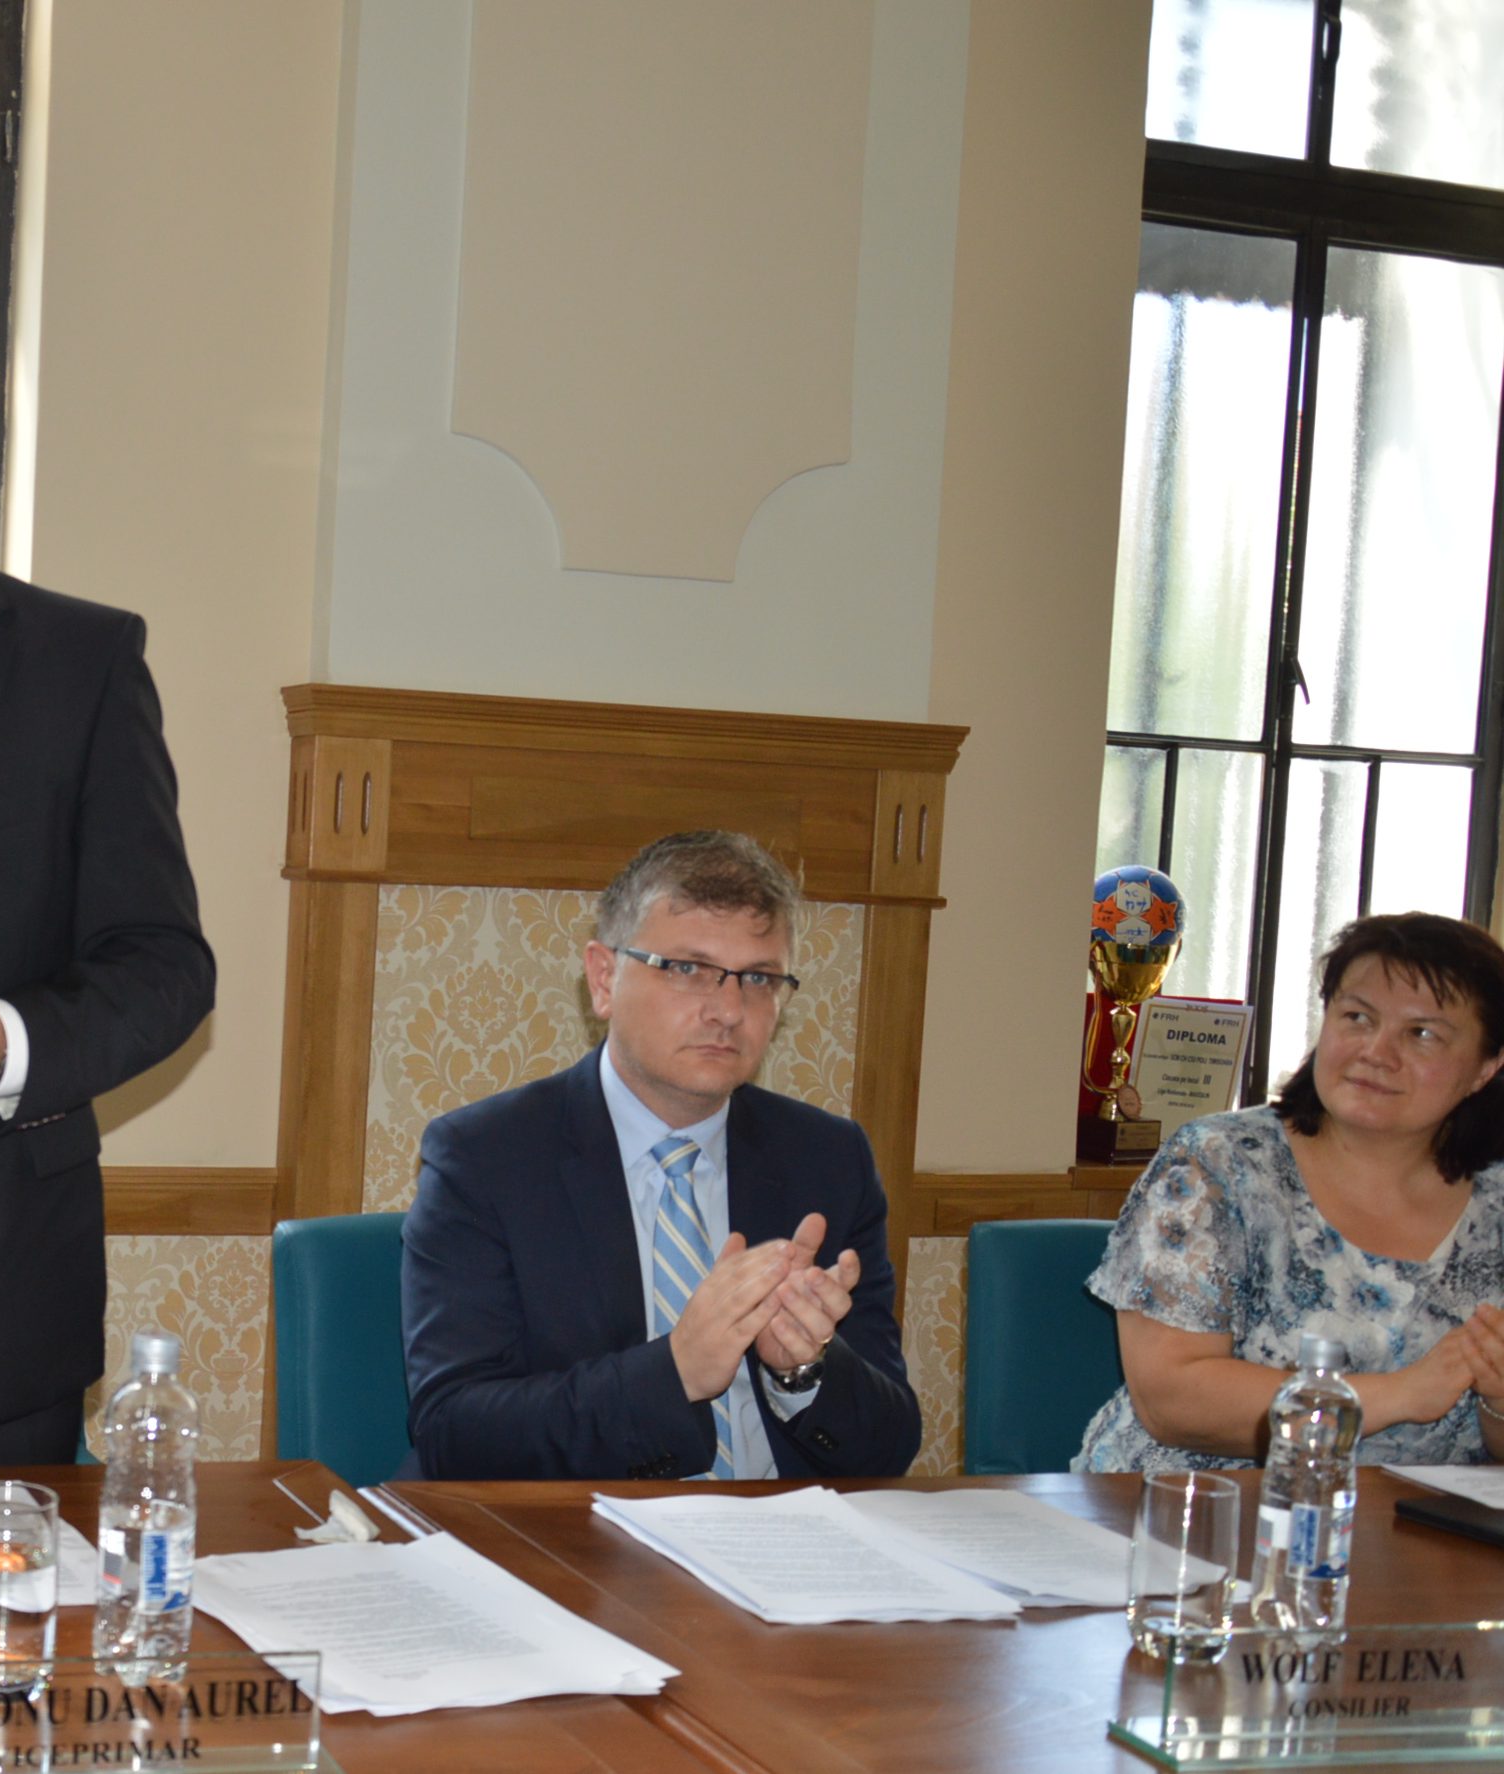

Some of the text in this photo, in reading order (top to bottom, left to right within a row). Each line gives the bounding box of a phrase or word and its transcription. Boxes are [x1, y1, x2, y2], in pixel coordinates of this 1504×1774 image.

[1166, 1028, 1227, 1046] DIPLOMA
[1241, 1648, 1466, 1685] WOLF ELENA
[84, 1682, 170, 1725] DAN
[172, 1677, 314, 1720] AUREL
[1288, 1696, 1412, 1719] CONSILIER
